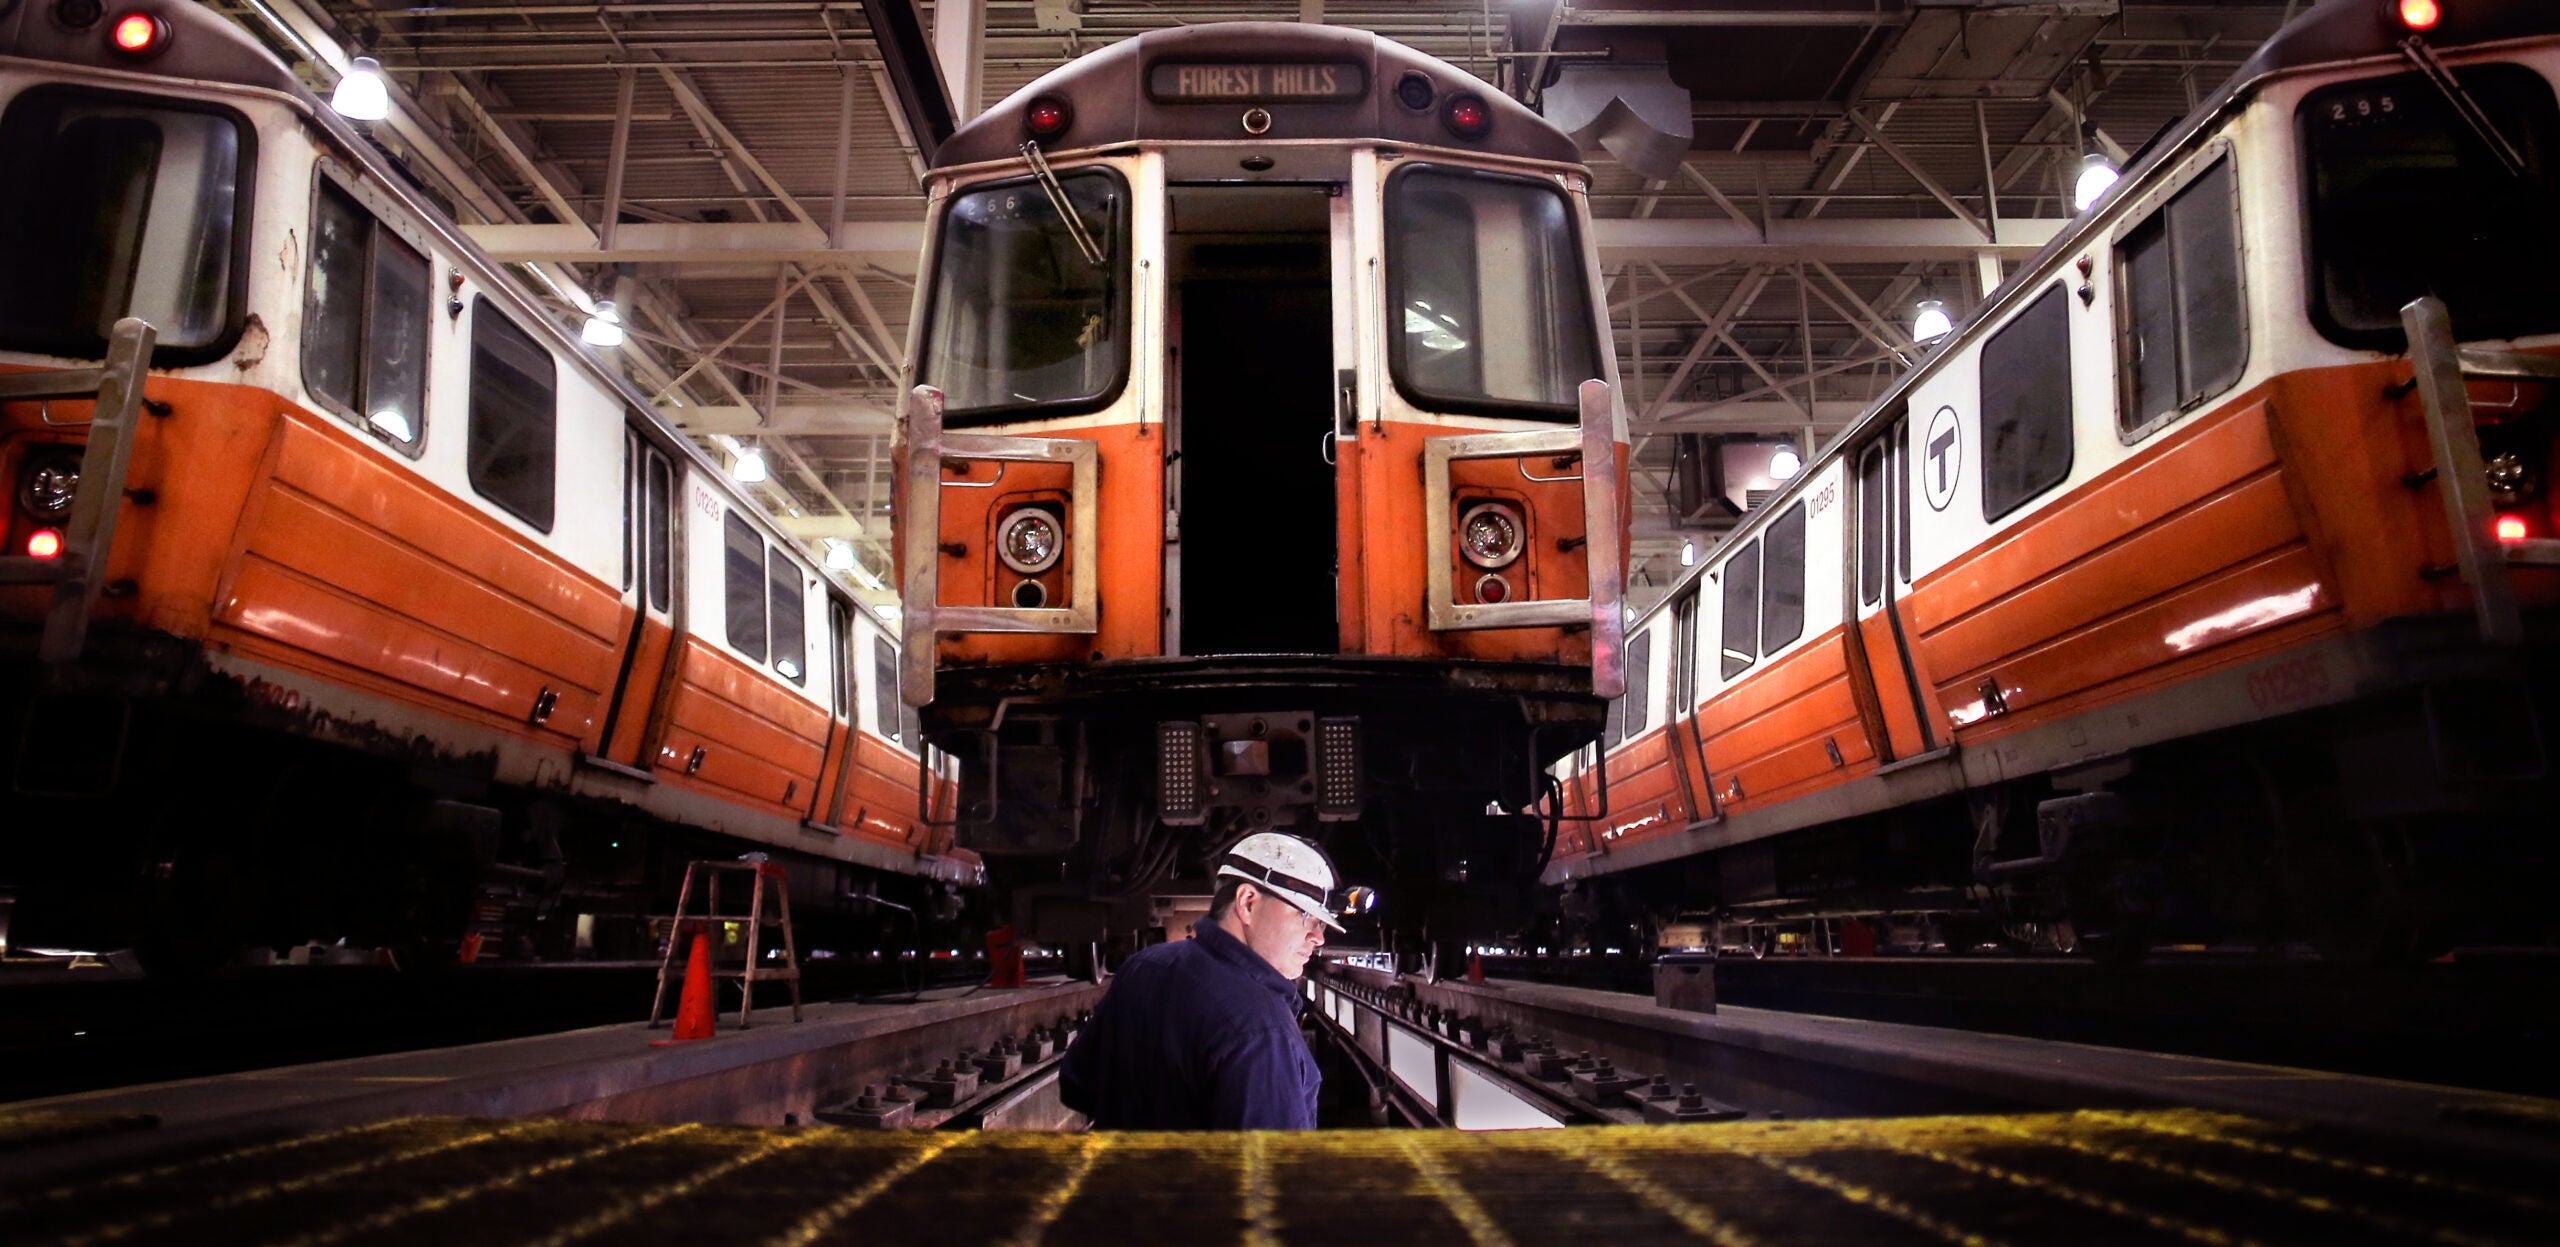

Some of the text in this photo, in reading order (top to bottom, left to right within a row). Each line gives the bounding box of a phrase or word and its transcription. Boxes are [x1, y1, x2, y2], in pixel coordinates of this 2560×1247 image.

[1178, 66, 1336, 96] FOREST HILLS
[1810, 481, 1834, 519] 01295
